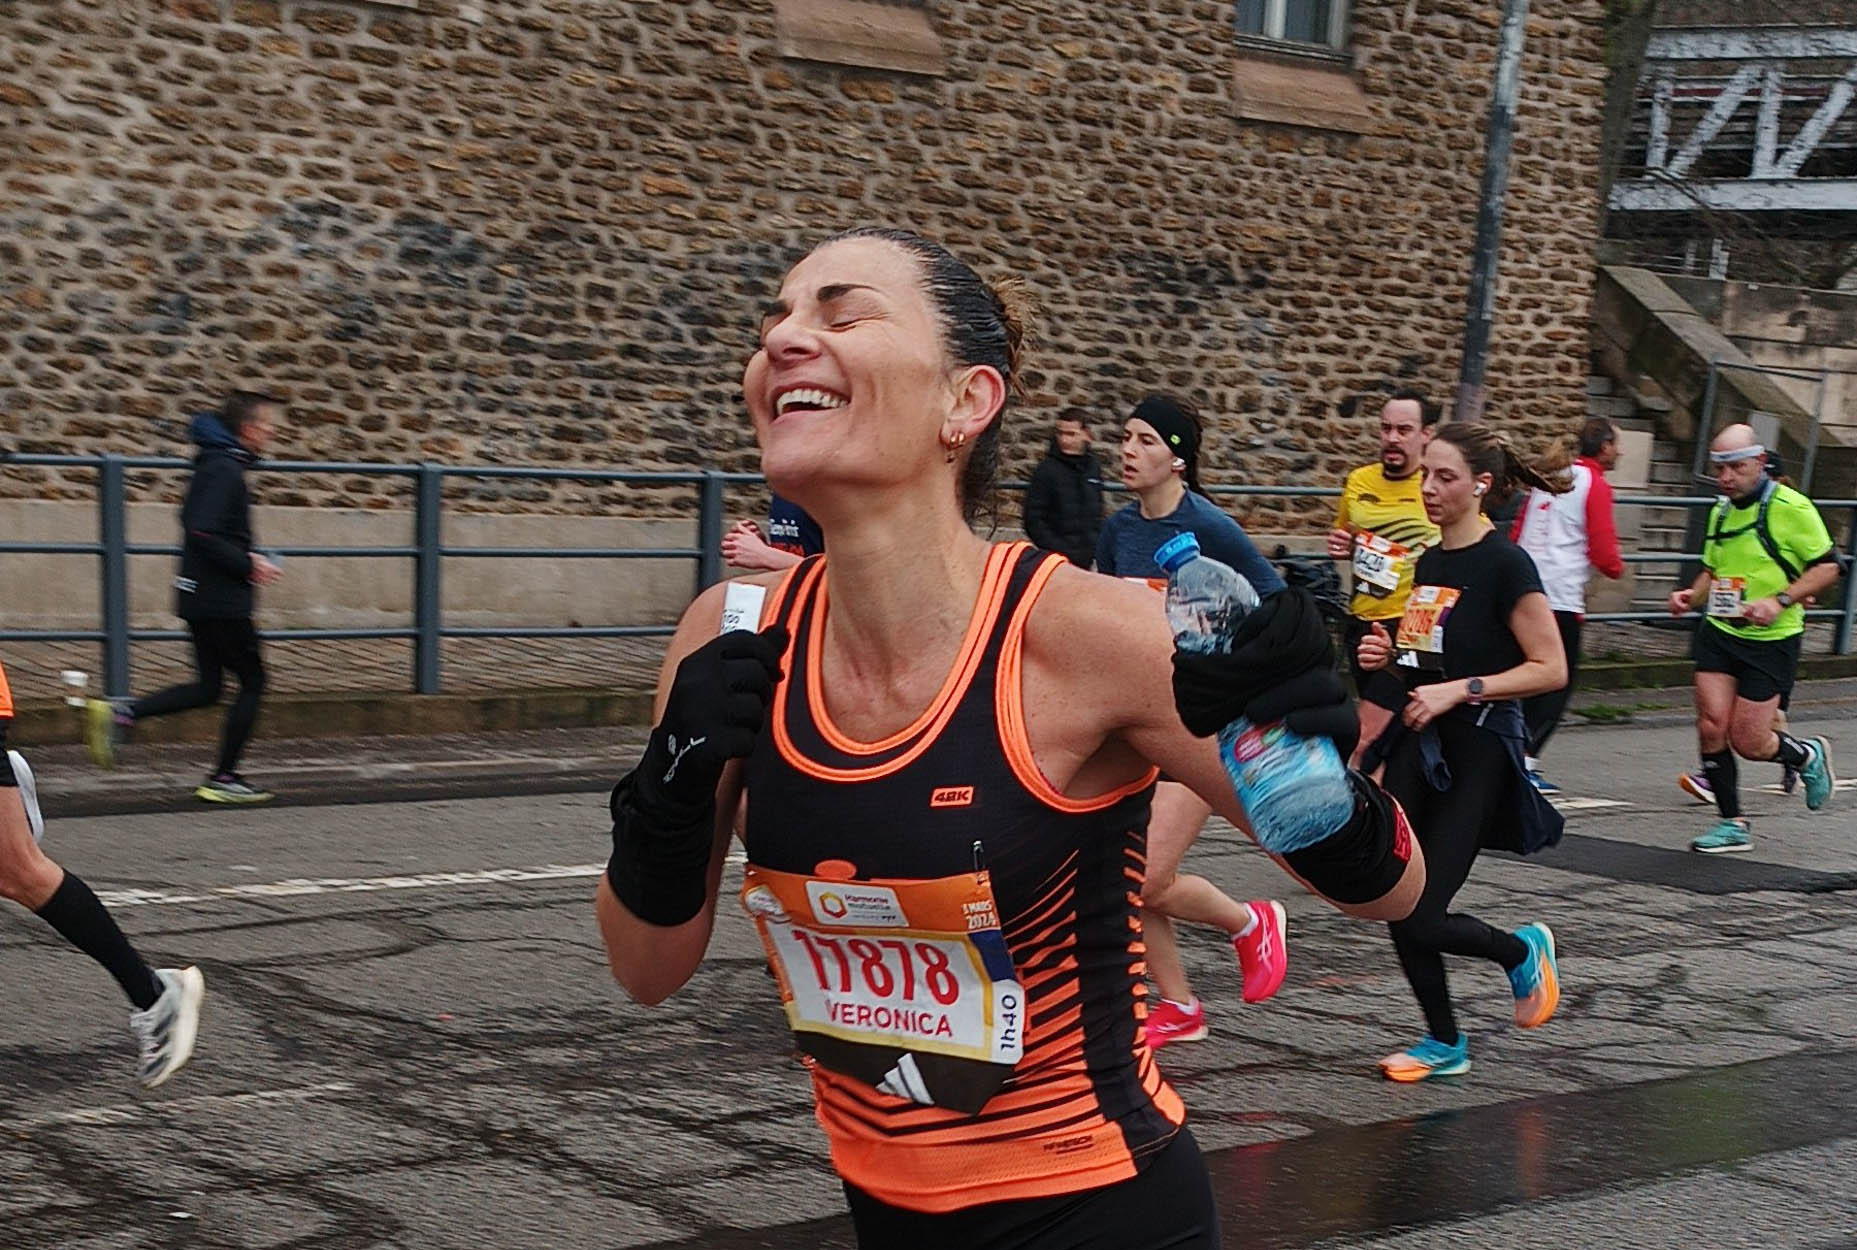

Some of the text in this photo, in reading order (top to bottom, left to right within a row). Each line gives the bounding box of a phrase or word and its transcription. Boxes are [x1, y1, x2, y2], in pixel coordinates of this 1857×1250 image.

[966, 912, 998, 930] 2024
[793, 931, 960, 1006] 17878
[825, 1000, 953, 1038] VERONICA
[1000, 994, 1017, 1051] 1h40
